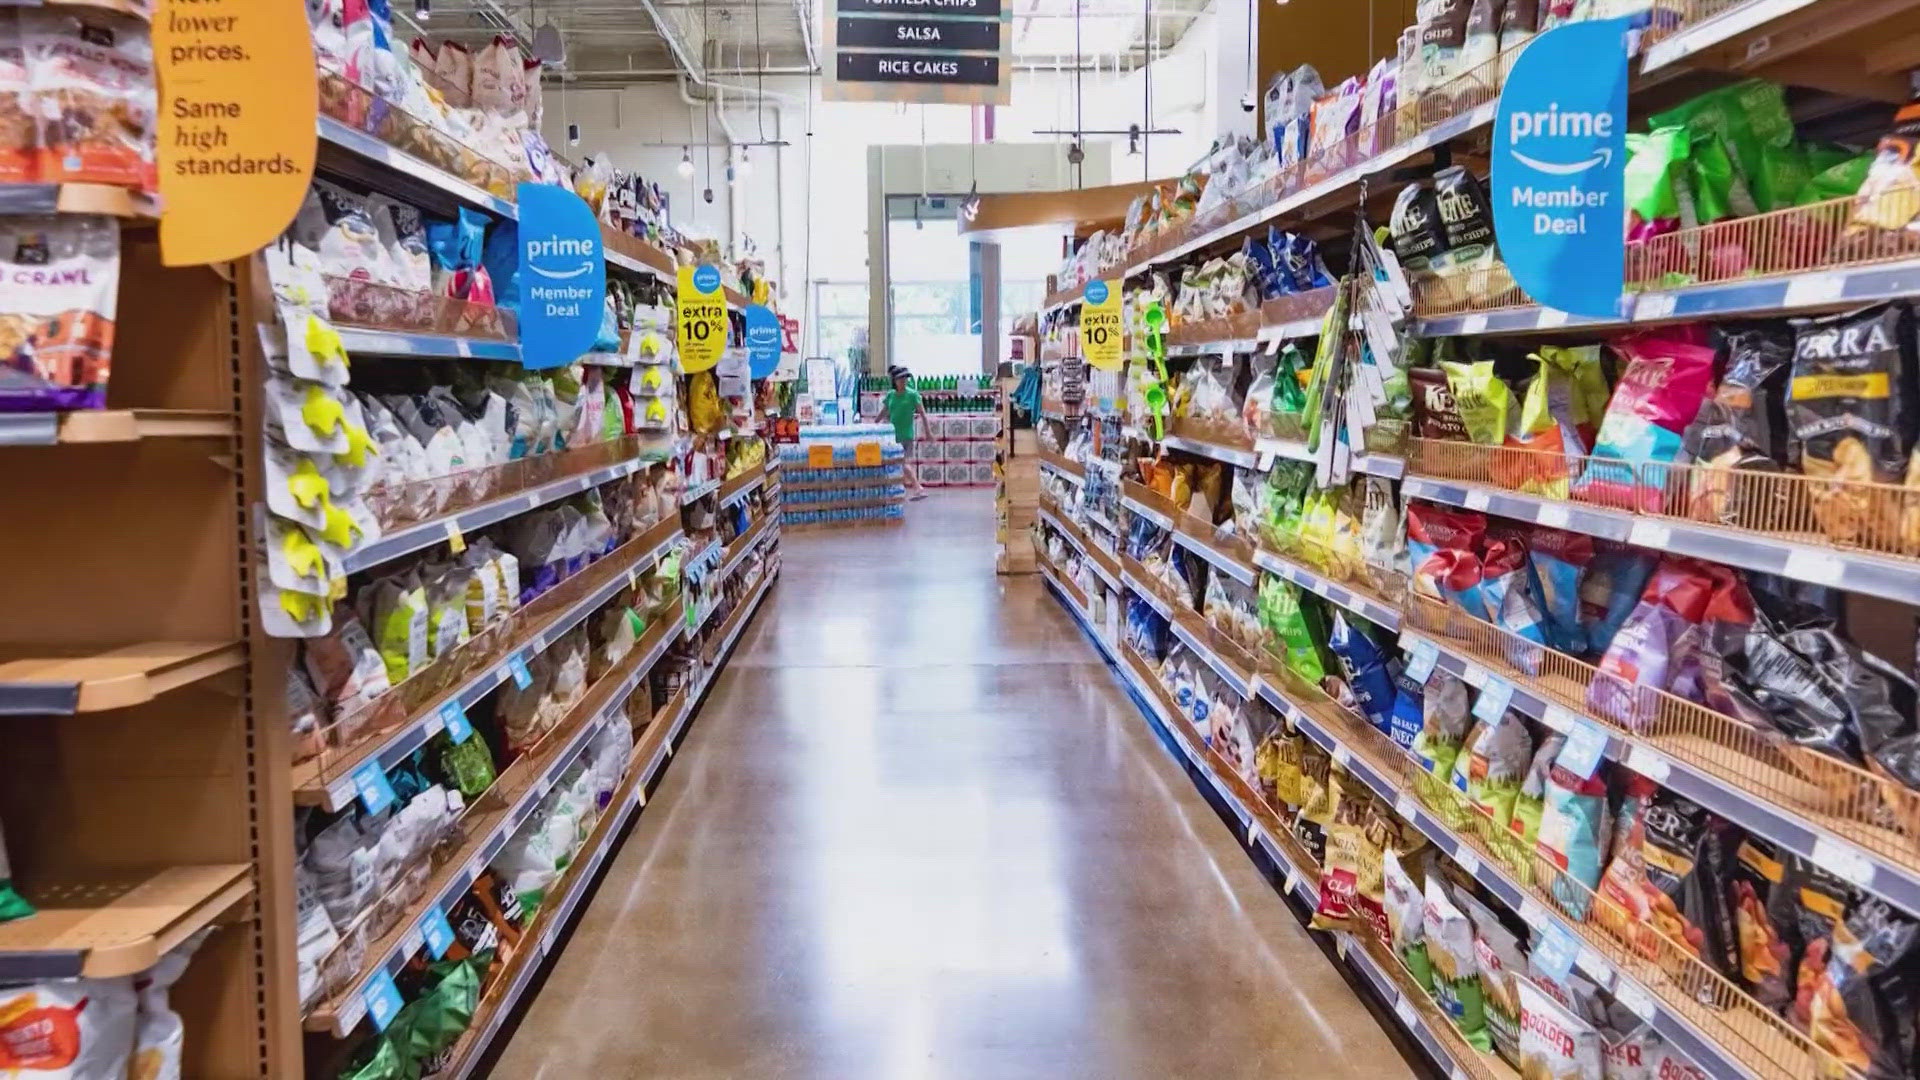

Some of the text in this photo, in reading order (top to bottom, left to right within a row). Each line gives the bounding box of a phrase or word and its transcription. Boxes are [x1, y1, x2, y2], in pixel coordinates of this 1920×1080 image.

[168, 10, 238, 33] lower
[897, 26, 941, 40] SALSA
[170, 39, 251, 66] prices.
[878, 61, 958, 75] RICE CAKES
[173, 97, 241, 118] Same
[1510, 102, 1613, 145] prime
[174, 125, 228, 153] high
[175, 153, 302, 175] standards.
[1512, 185, 1609, 207] Member
[1533, 213, 1587, 235] Deal
[527, 233, 594, 262] prime
[13, 268, 92, 287] CRAWL
[531, 286, 594, 300] Member
[546, 302, 580, 317] Deal
[682, 305, 723, 318] extra
[1084, 314, 1119, 325] extra
[683, 319, 723, 341] 10%
[749, 326, 777, 337] prime
[1084, 326, 1119, 345] 10%
[1391, 726, 1414, 745] INEG
[1520, 1007, 1575, 1059] BOULDER
